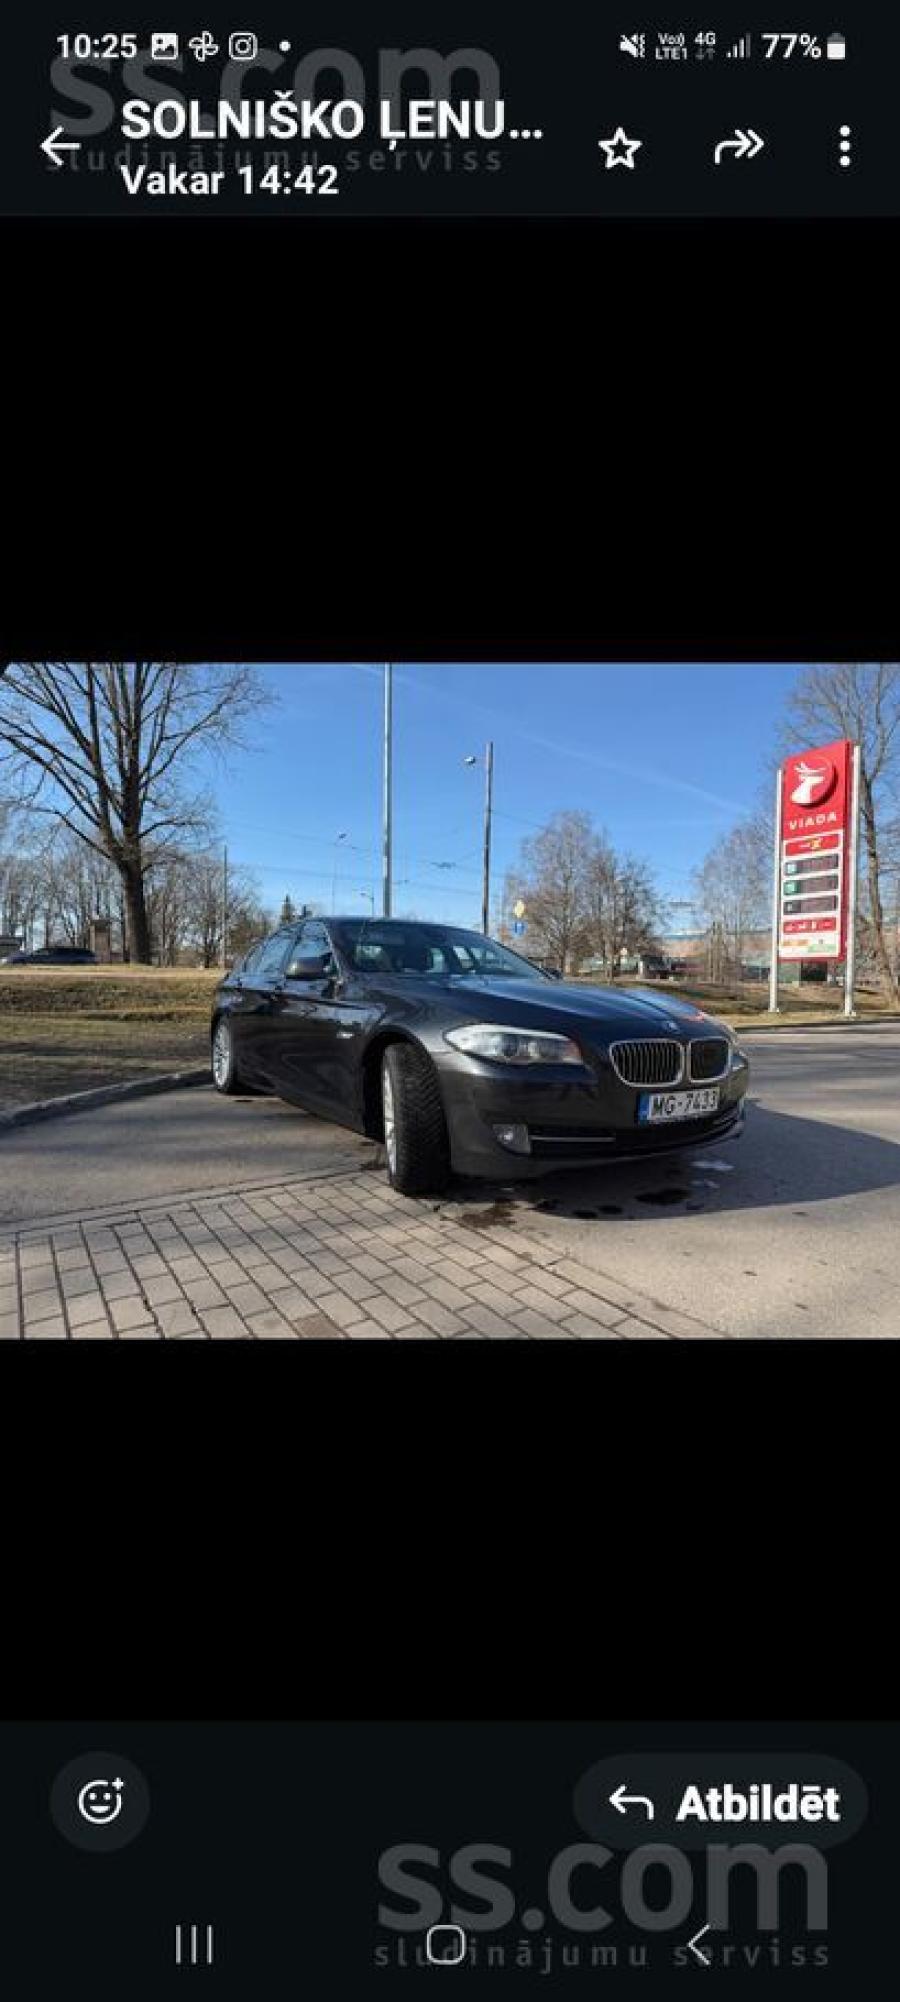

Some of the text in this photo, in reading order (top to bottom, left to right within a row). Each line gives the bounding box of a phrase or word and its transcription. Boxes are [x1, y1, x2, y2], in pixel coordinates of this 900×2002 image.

[56, 34, 138, 59] 10:25
[694, 32, 716, 46] 4G
[761, 33, 822, 59] 77%
[120, 90, 365, 141] SOLNIŠKO
[121, 165, 339, 195] Vakar 14:42
[788, 811, 837, 830] VIADA
[675, 1783, 841, 1822] Atbildēt
